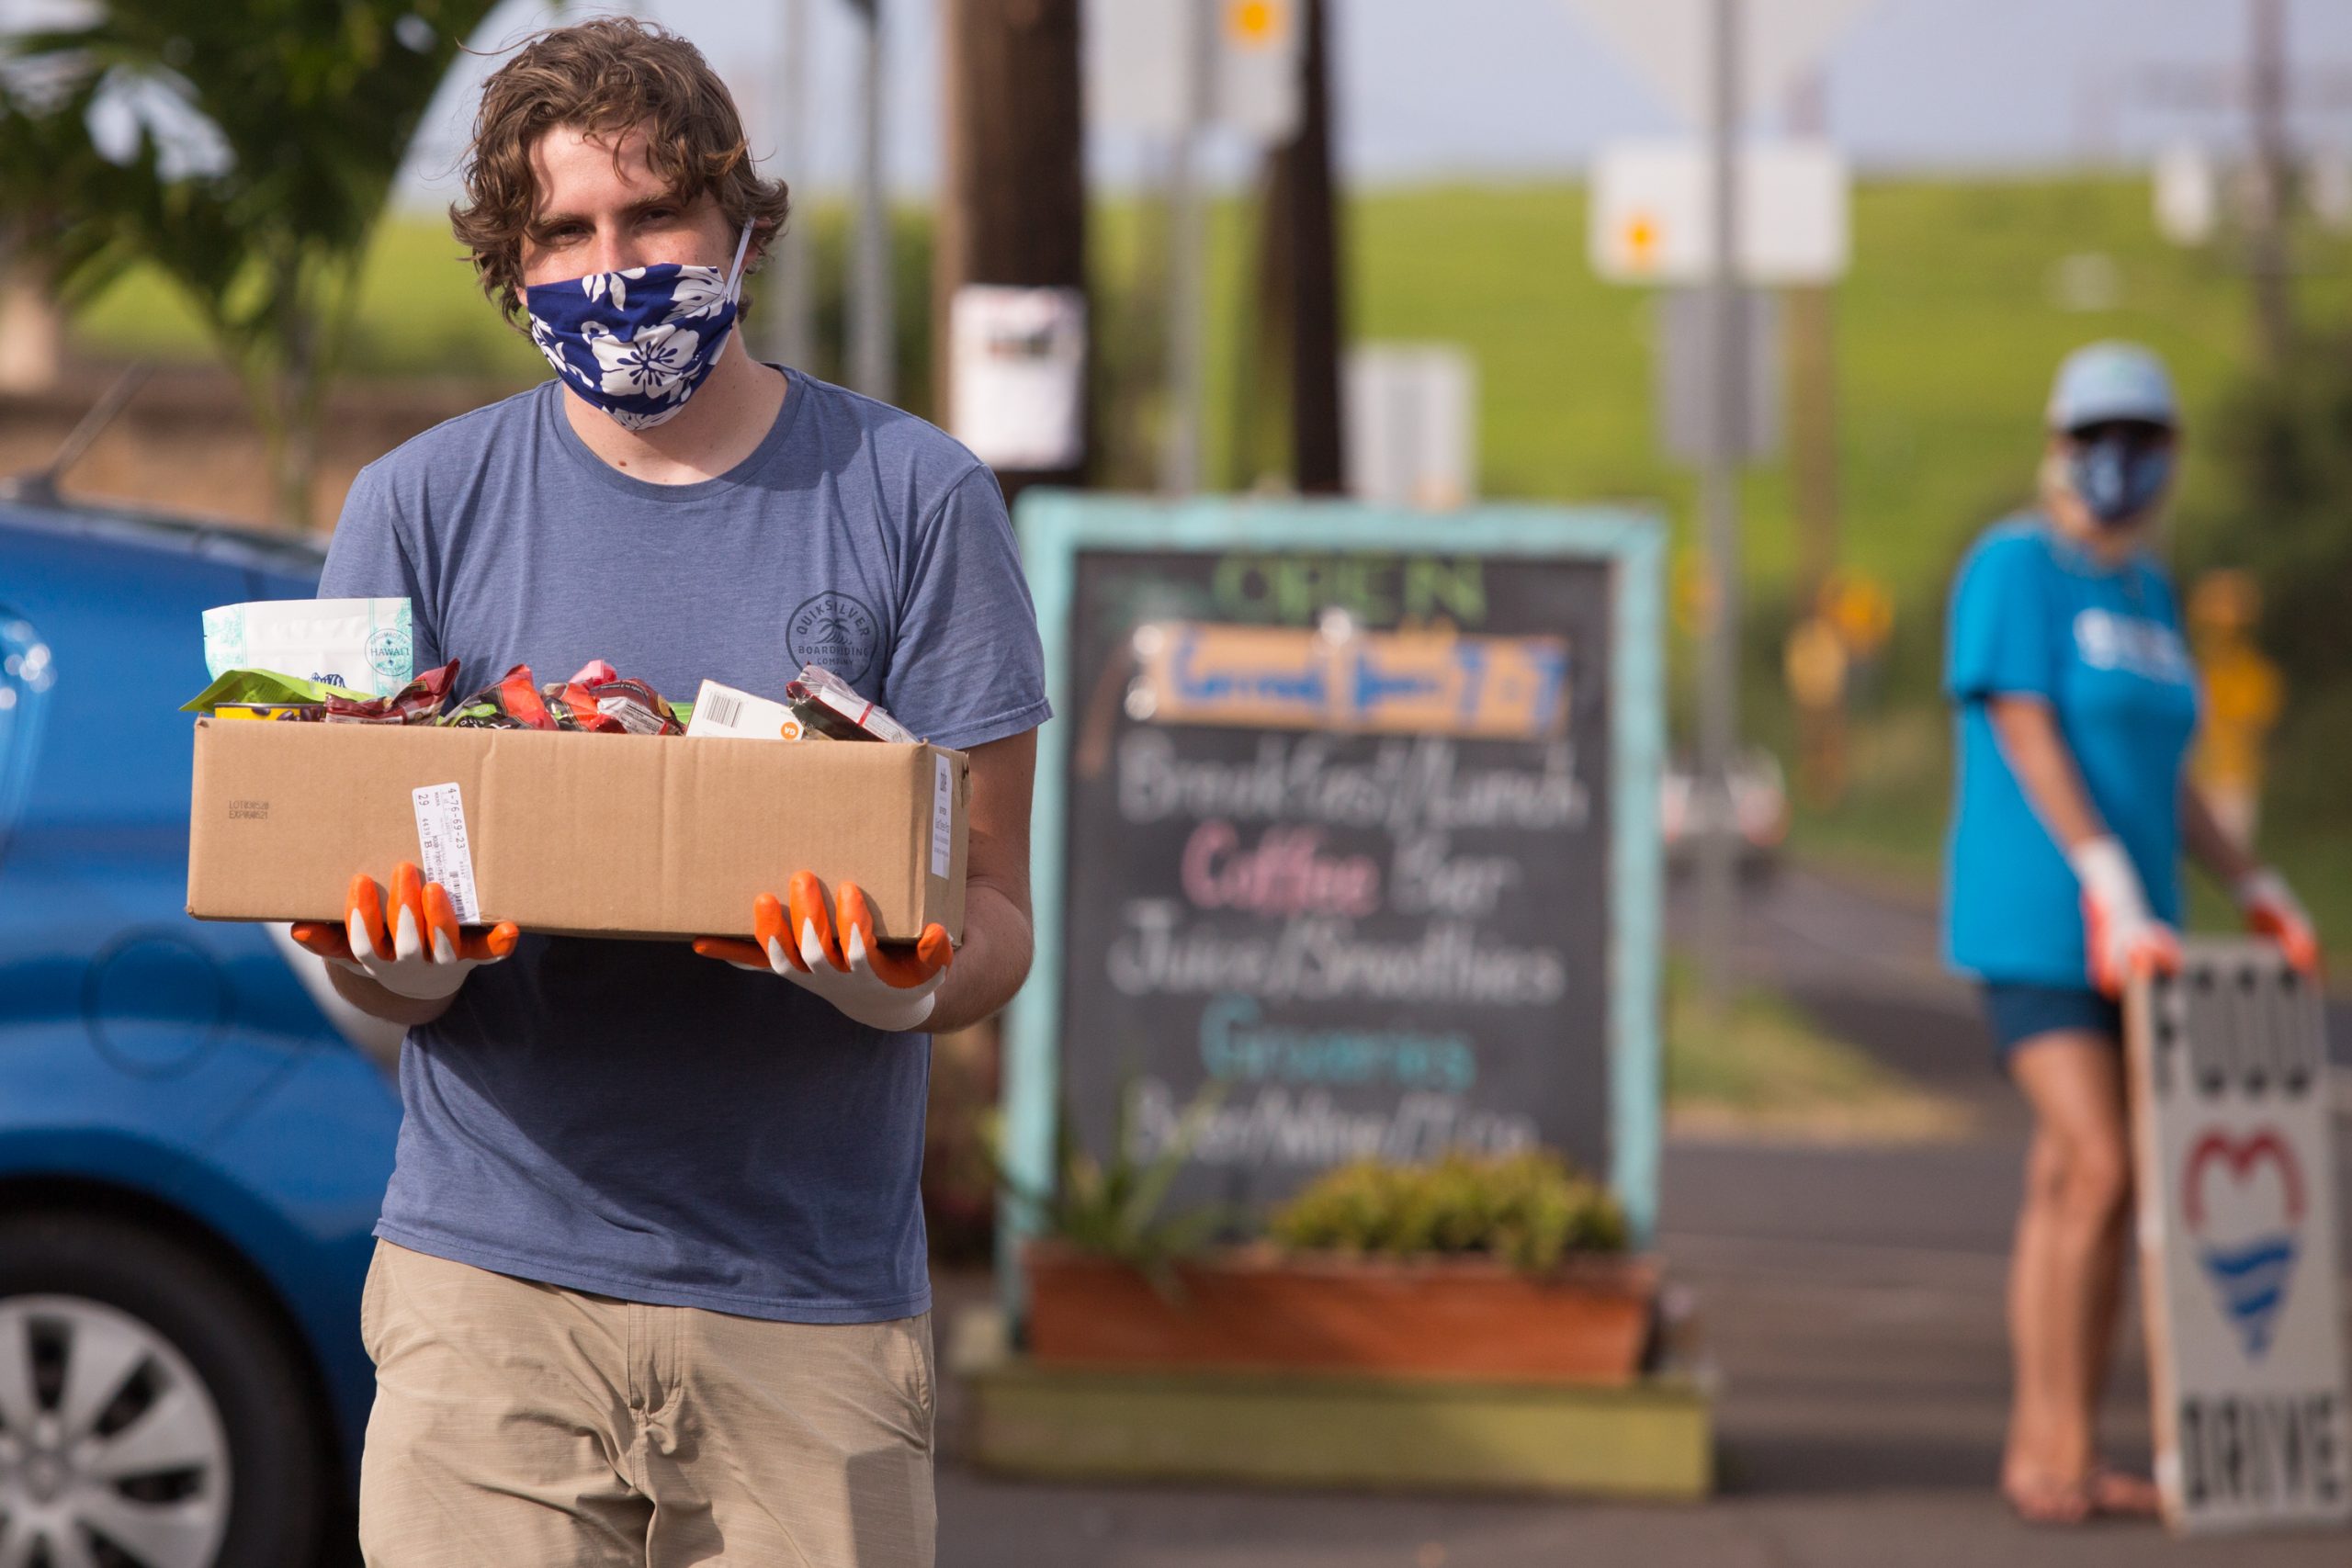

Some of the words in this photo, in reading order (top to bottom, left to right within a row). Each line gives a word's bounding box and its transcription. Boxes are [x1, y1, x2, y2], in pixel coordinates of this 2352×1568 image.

[796, 600, 871, 637] QUIKSILVER
[1216, 553, 1484, 625] OPEN
[418, 793, 430, 807] 29
[447, 787, 466, 850] 4-76-69-23
[1186, 823, 1378, 914] Coffee
[1392, 829, 1520, 910] Bar
[1111, 902, 1563, 1001] Juice/Smoothies
[1203, 997, 1476, 1089] Groceries
[2152, 958, 2315, 1101] FOOD
[2177, 1391, 2345, 1508] DRIVE
